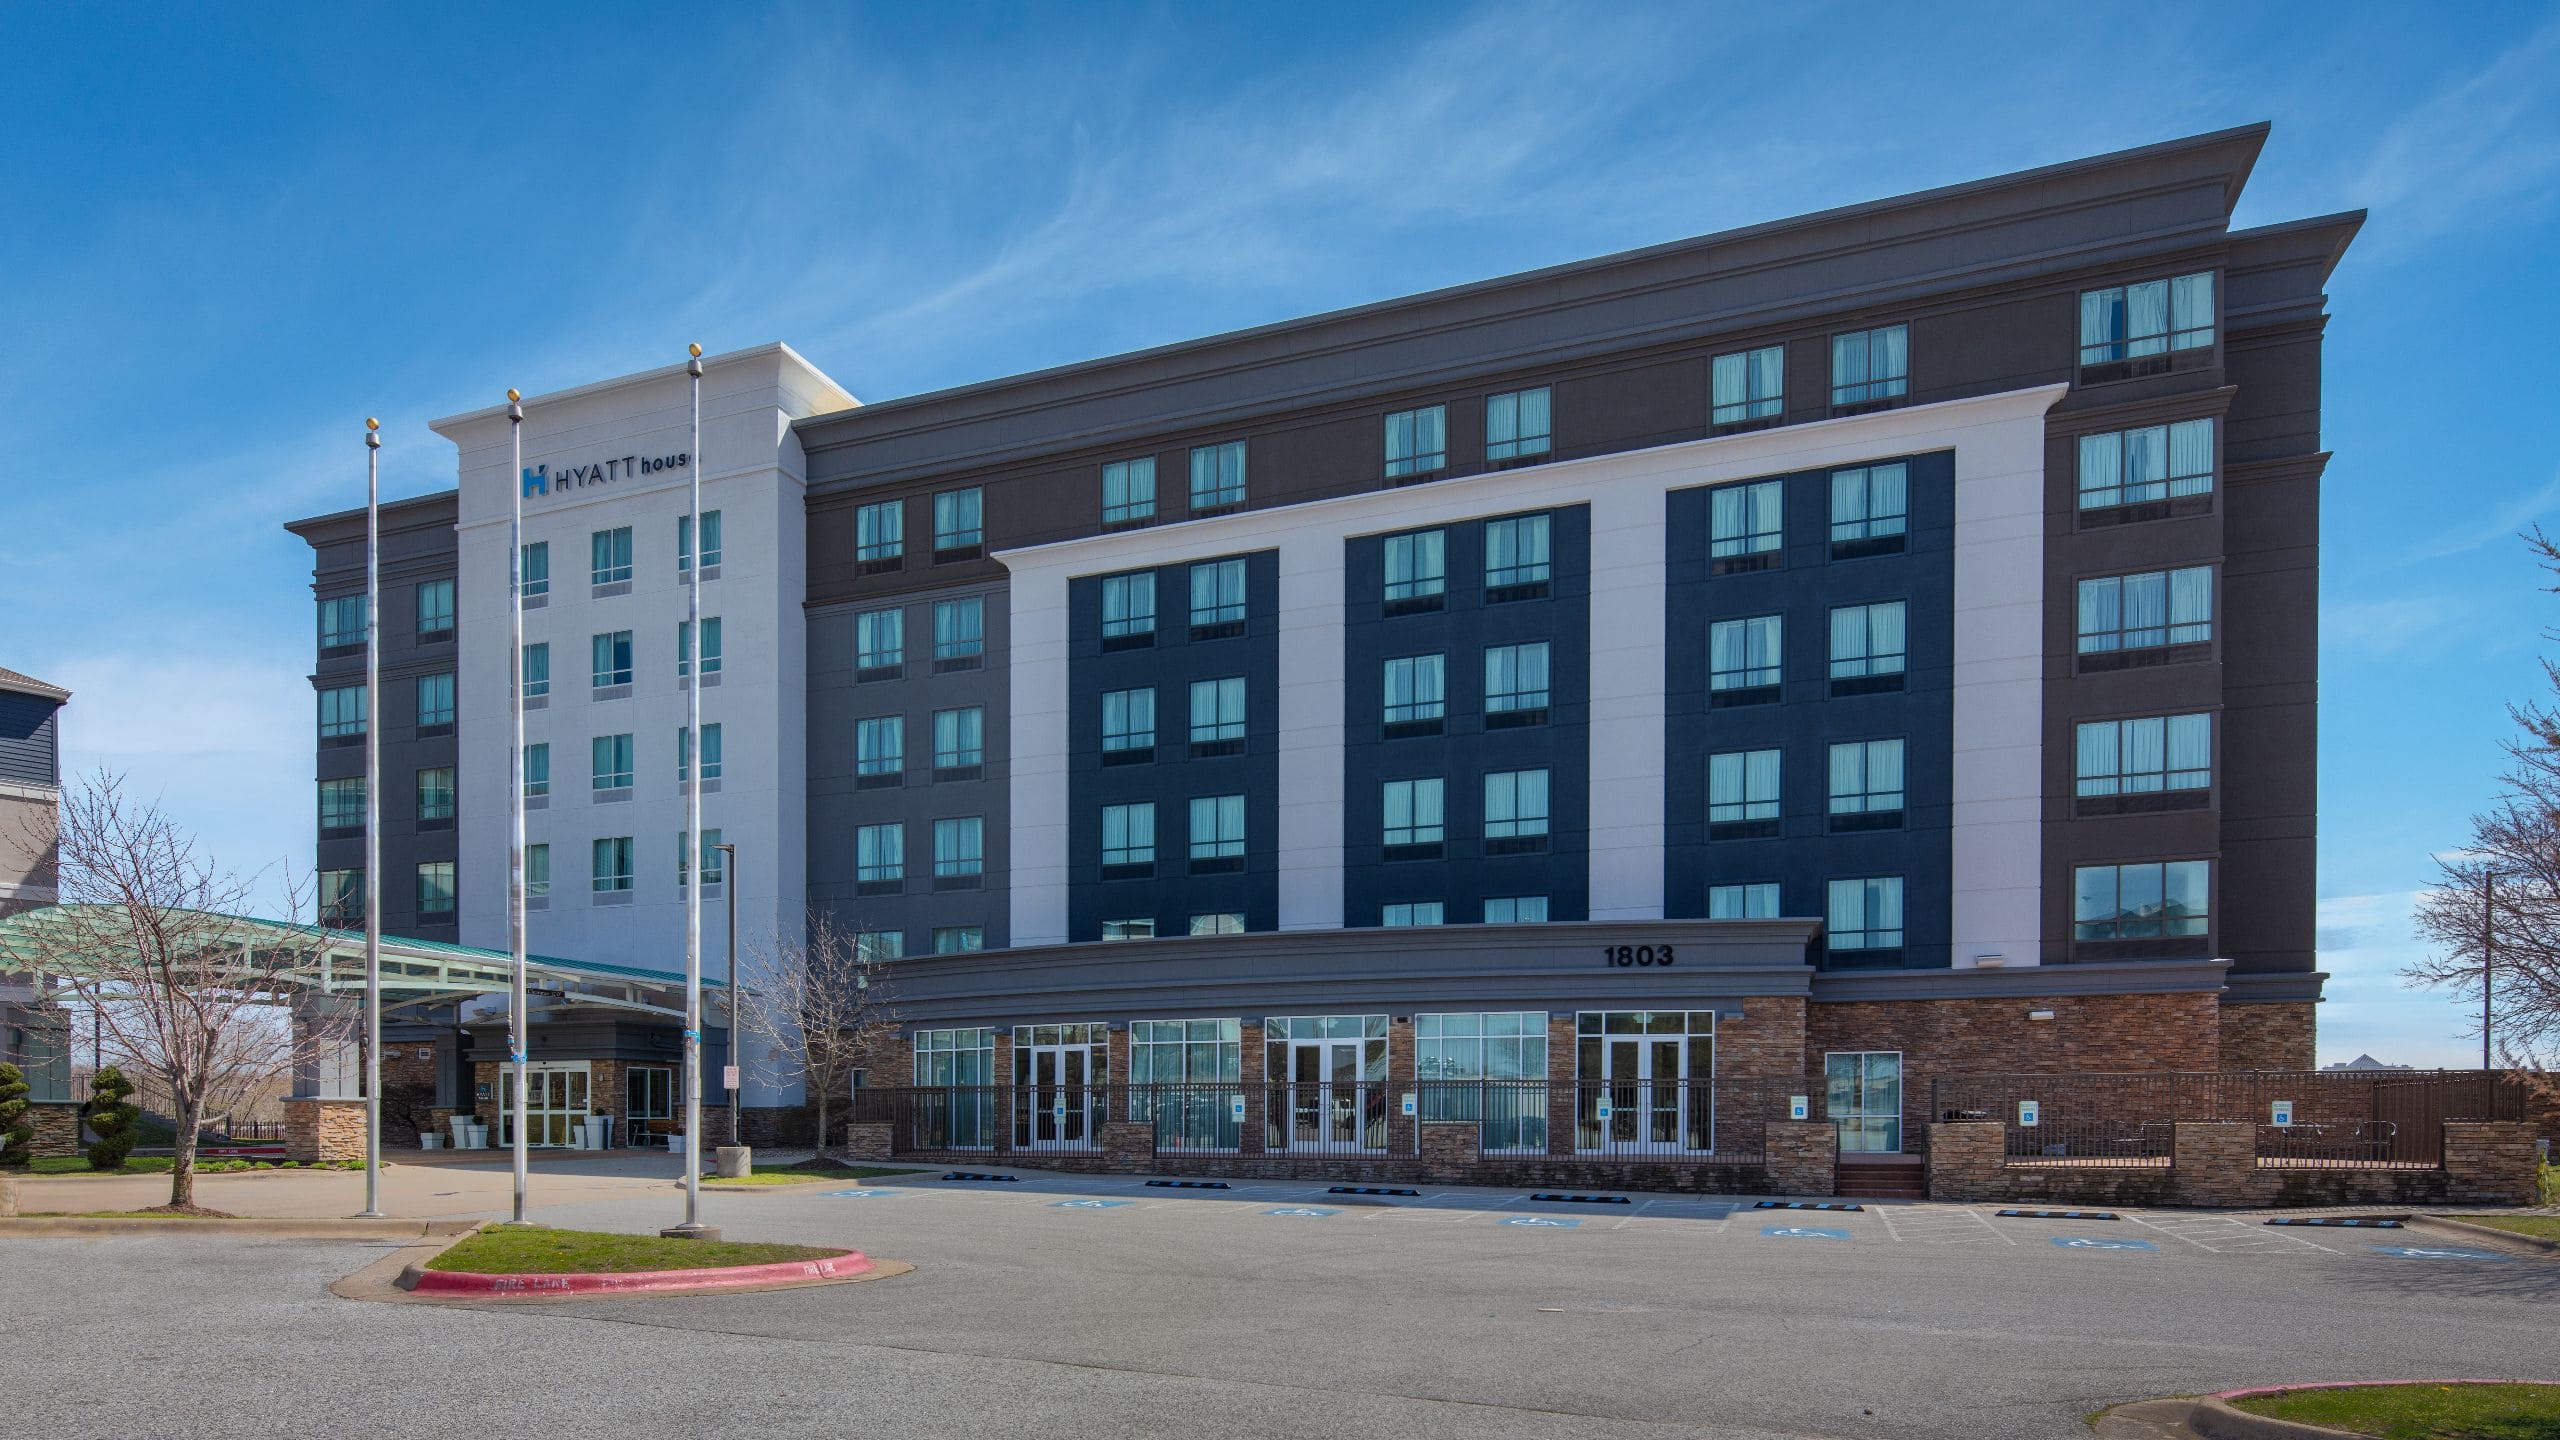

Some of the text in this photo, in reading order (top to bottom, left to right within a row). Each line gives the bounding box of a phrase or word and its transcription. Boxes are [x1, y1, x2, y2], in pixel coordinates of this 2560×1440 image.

[556, 456, 635, 492] HYATT
[641, 453, 692, 474] hous
[1604, 944, 1674, 967] 1803
